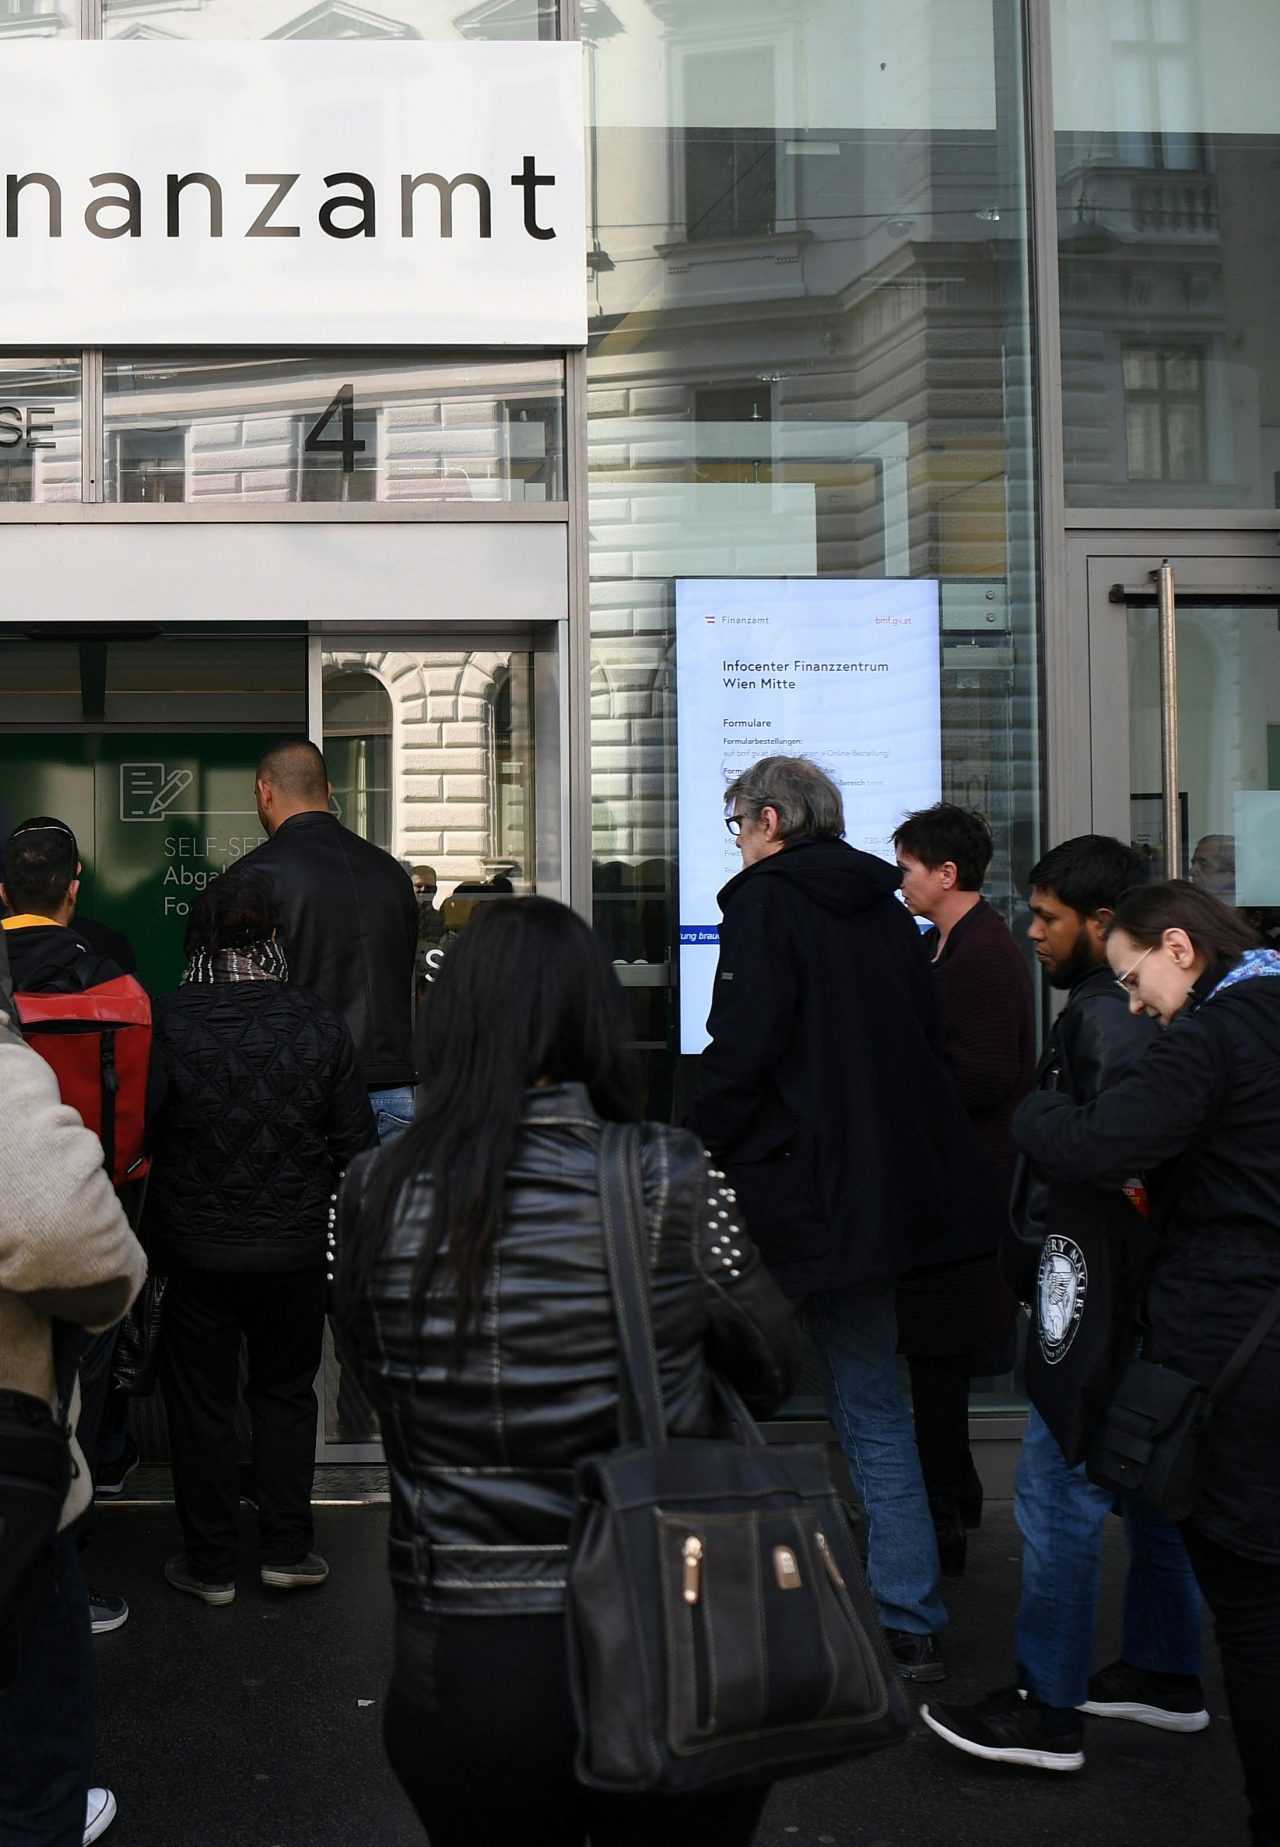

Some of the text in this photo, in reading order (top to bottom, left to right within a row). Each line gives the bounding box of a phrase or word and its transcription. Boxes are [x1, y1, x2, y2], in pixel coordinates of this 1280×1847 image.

[304, 383, 366, 473] 4
[722, 616, 769, 624] Finanzamt
[875, 616, 912, 626] bmf.gv.at
[723, 659, 889, 672] Infocenter Finanzzentrum
[723, 678, 796, 689] Wien Mitte
[723, 718, 772, 728] Formulare
[723, 738, 803, 746] Formularbestellungen:
